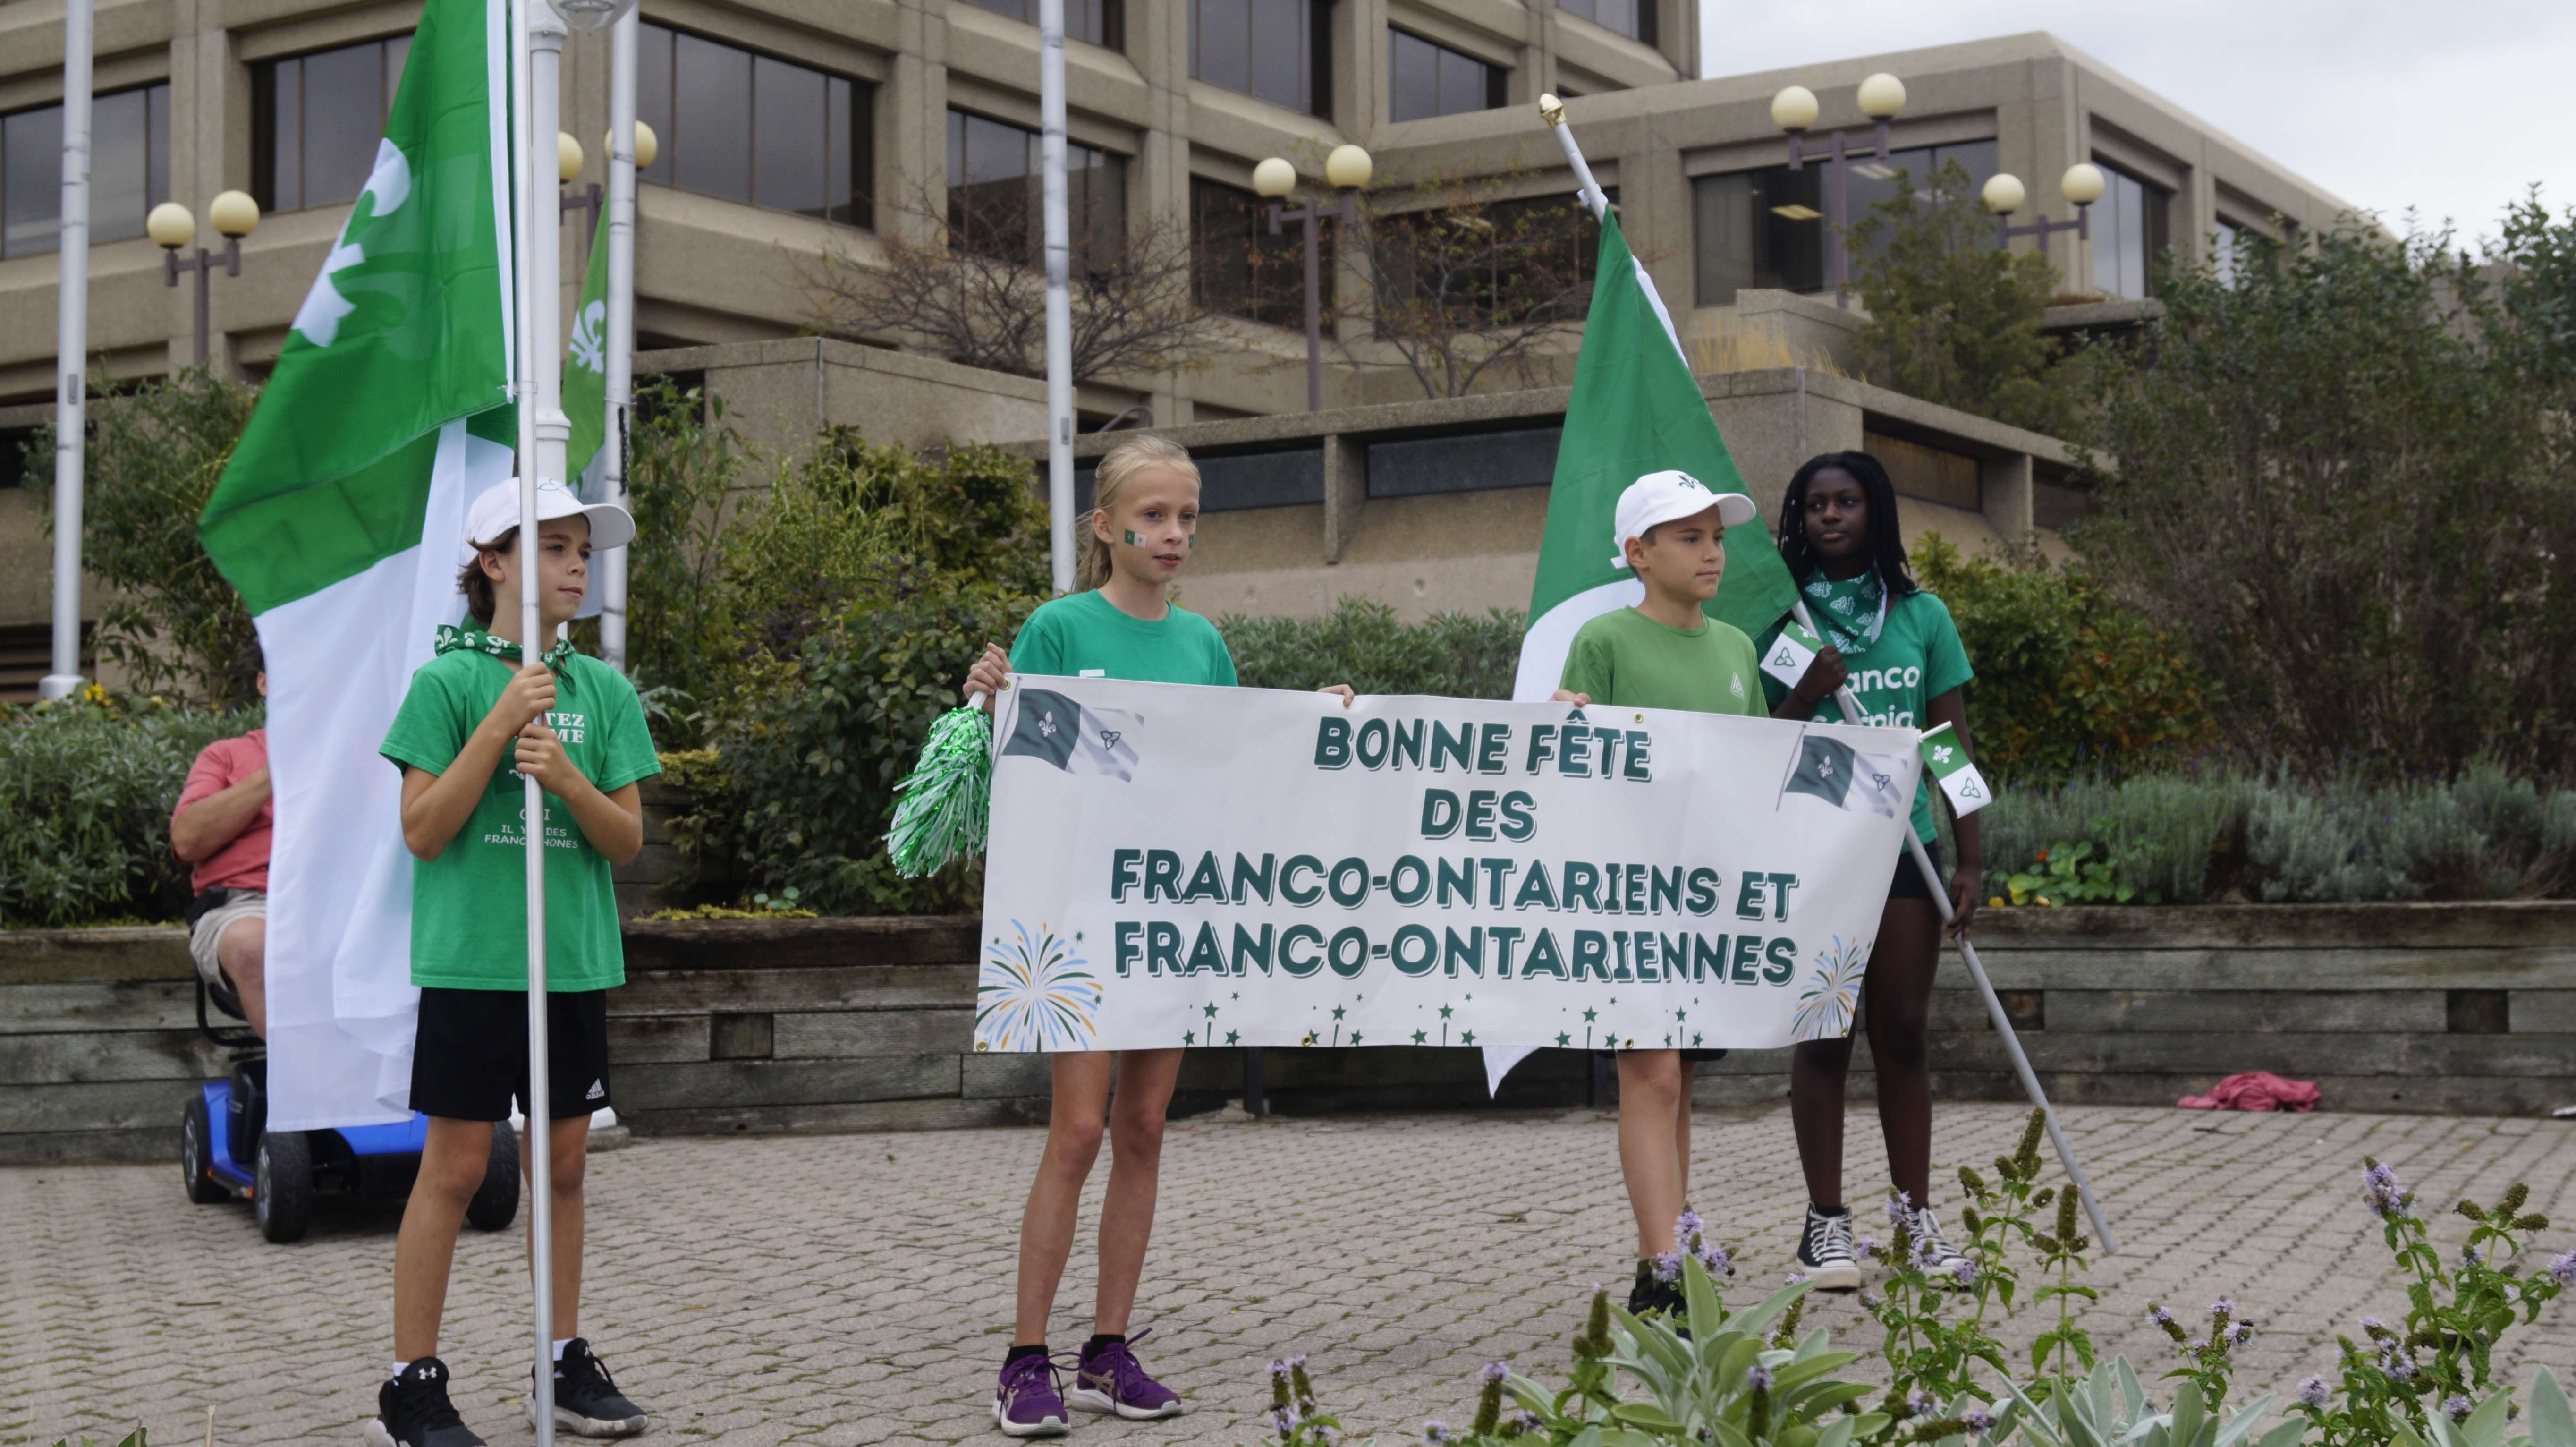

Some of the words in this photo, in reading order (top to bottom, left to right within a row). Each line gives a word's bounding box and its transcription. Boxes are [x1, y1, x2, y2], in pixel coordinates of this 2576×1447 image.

[1847, 666, 1920, 693] anco
[1314, 716, 1512, 775] BONNE
[1526, 709, 1652, 783] FÊTE
[484, 834, 578, 849] FRANCHONES
[501, 825, 514, 834] IL
[546, 827, 567, 837] DES
[1421, 788, 1537, 843] DES
[1111, 849, 1721, 916] FRANCO-ONTARIENS
[1736, 871, 1800, 922] ET
[1115, 921, 1797, 987] FRANCO-ONTARIENNES
